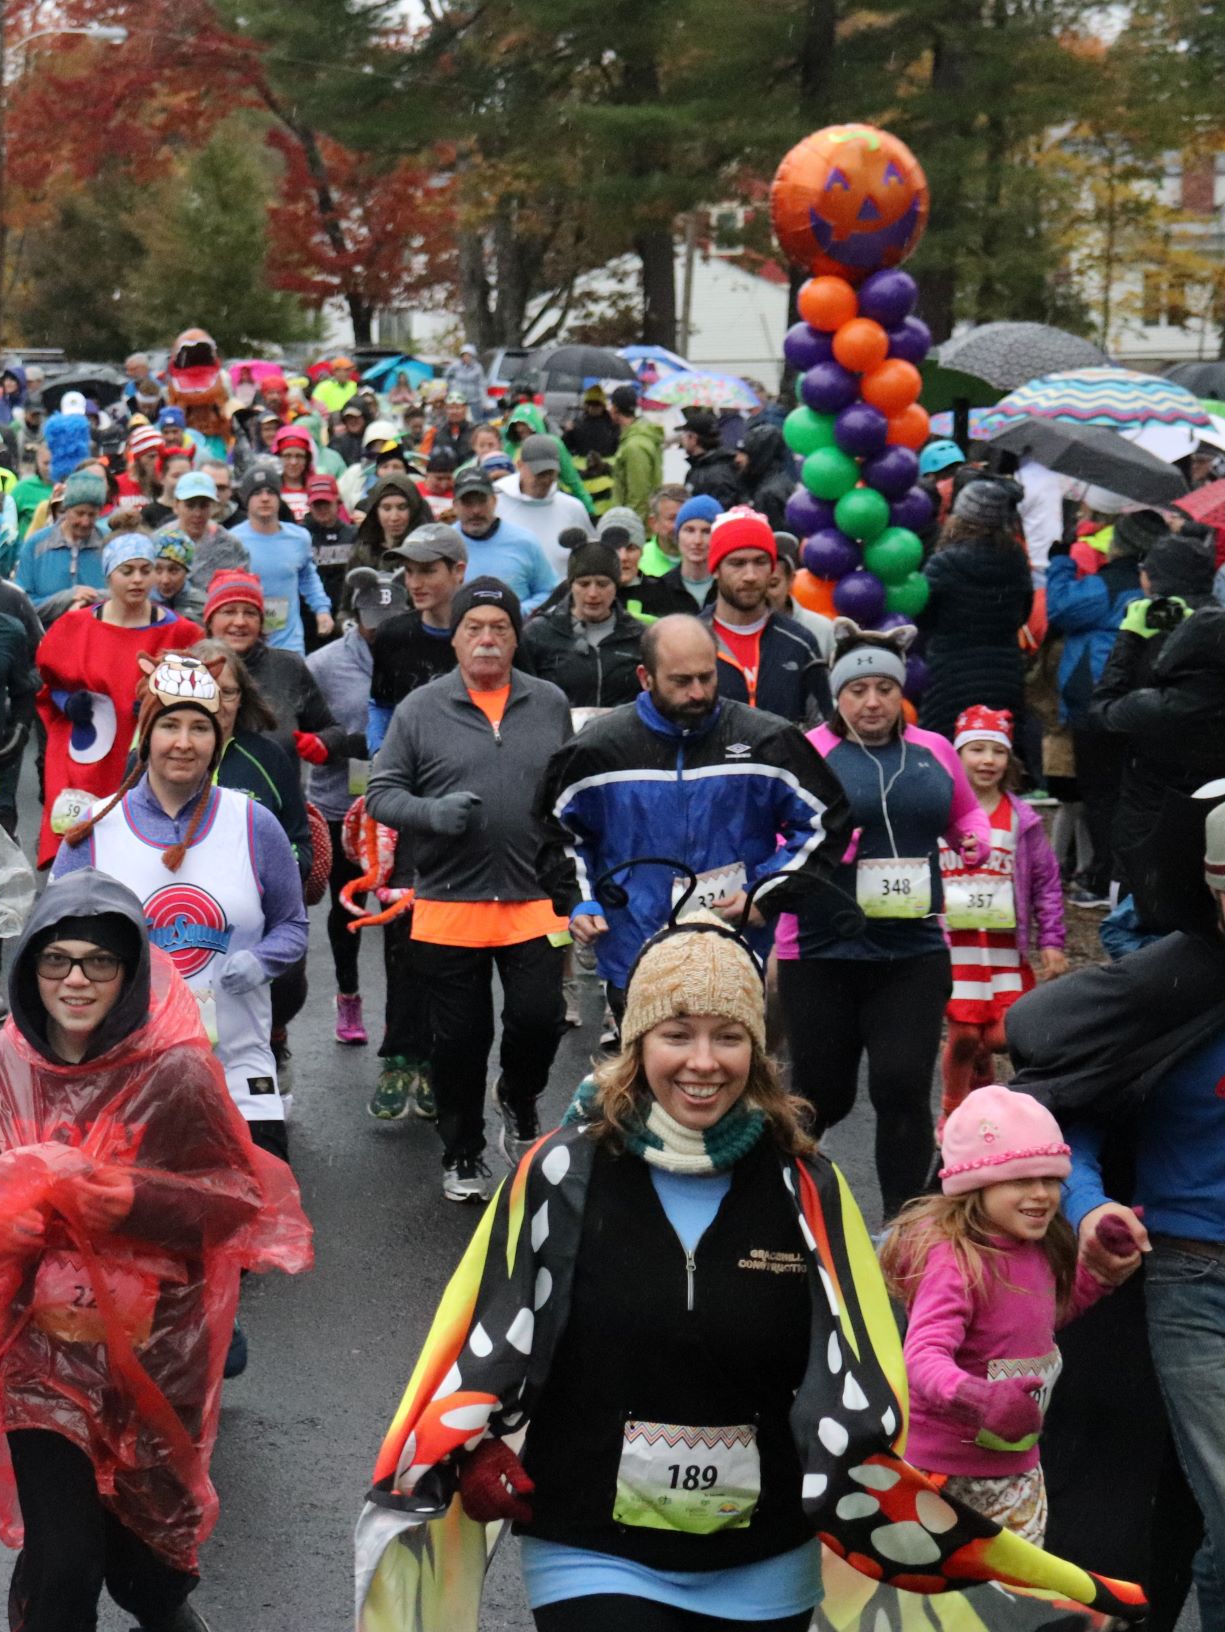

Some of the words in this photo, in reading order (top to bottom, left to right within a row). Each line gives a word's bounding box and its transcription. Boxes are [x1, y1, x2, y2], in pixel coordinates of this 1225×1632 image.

[379, 588, 392, 605] B
[66, 804, 81, 818] 59
[882, 878, 911, 896] 348
[967, 893, 993, 909] 357
[667, 1464, 718, 1491] 189
